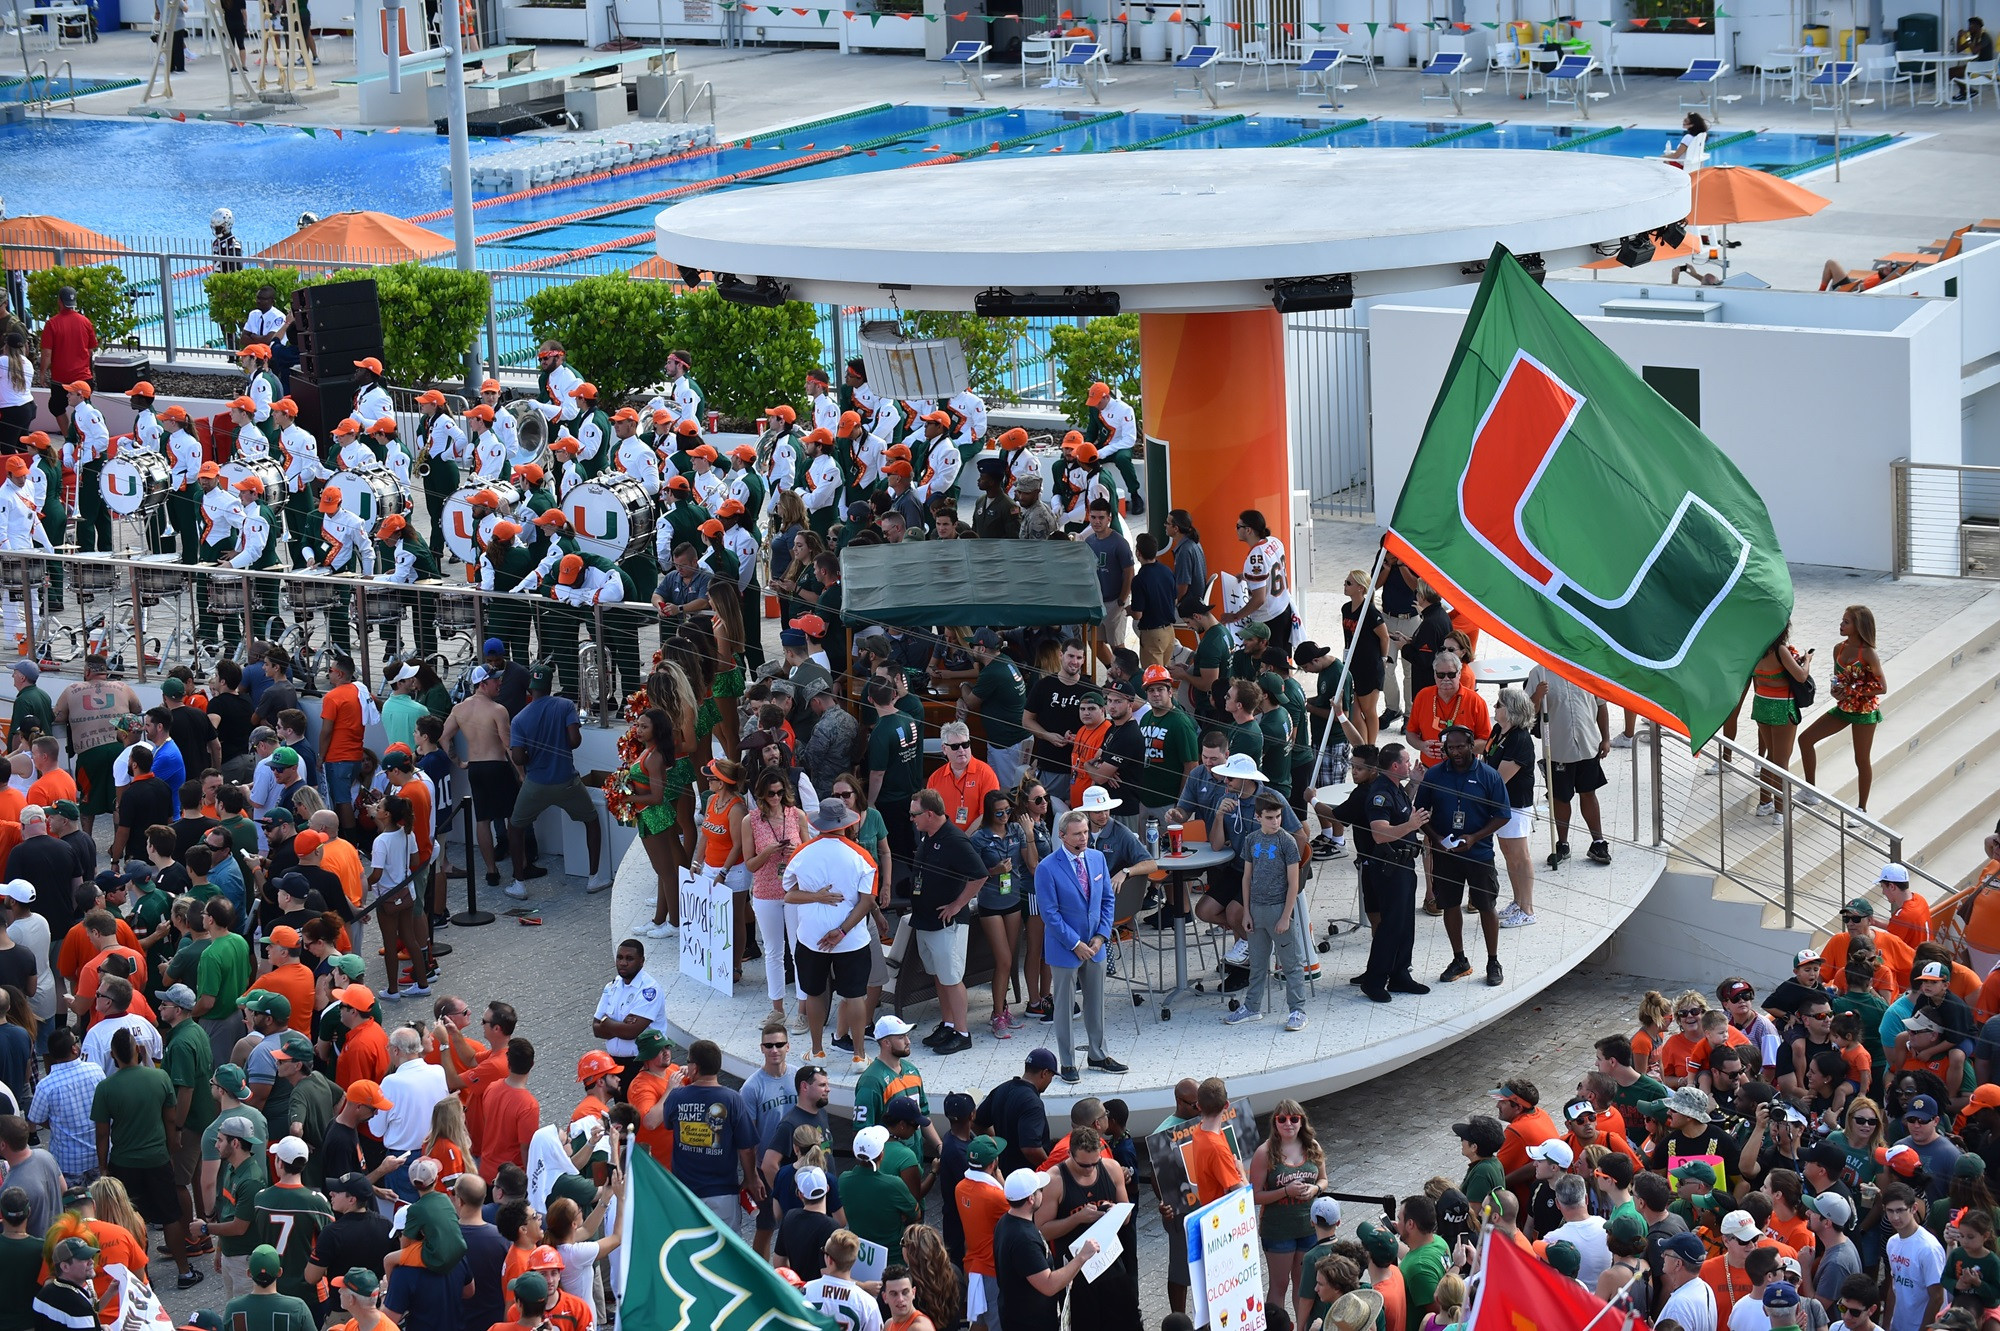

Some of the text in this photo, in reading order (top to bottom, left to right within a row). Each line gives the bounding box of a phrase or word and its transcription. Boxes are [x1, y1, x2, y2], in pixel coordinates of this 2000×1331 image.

[108, 474, 137, 496] U
[574, 506, 617, 540] U
[1050, 692, 1080, 708] Lyfe
[678, 1103, 705, 1113] NOTRE
[678, 1113, 702, 1121] DAME
[270, 1214, 294, 1256] 7
[822, 1284, 851, 1301] IRVIN
